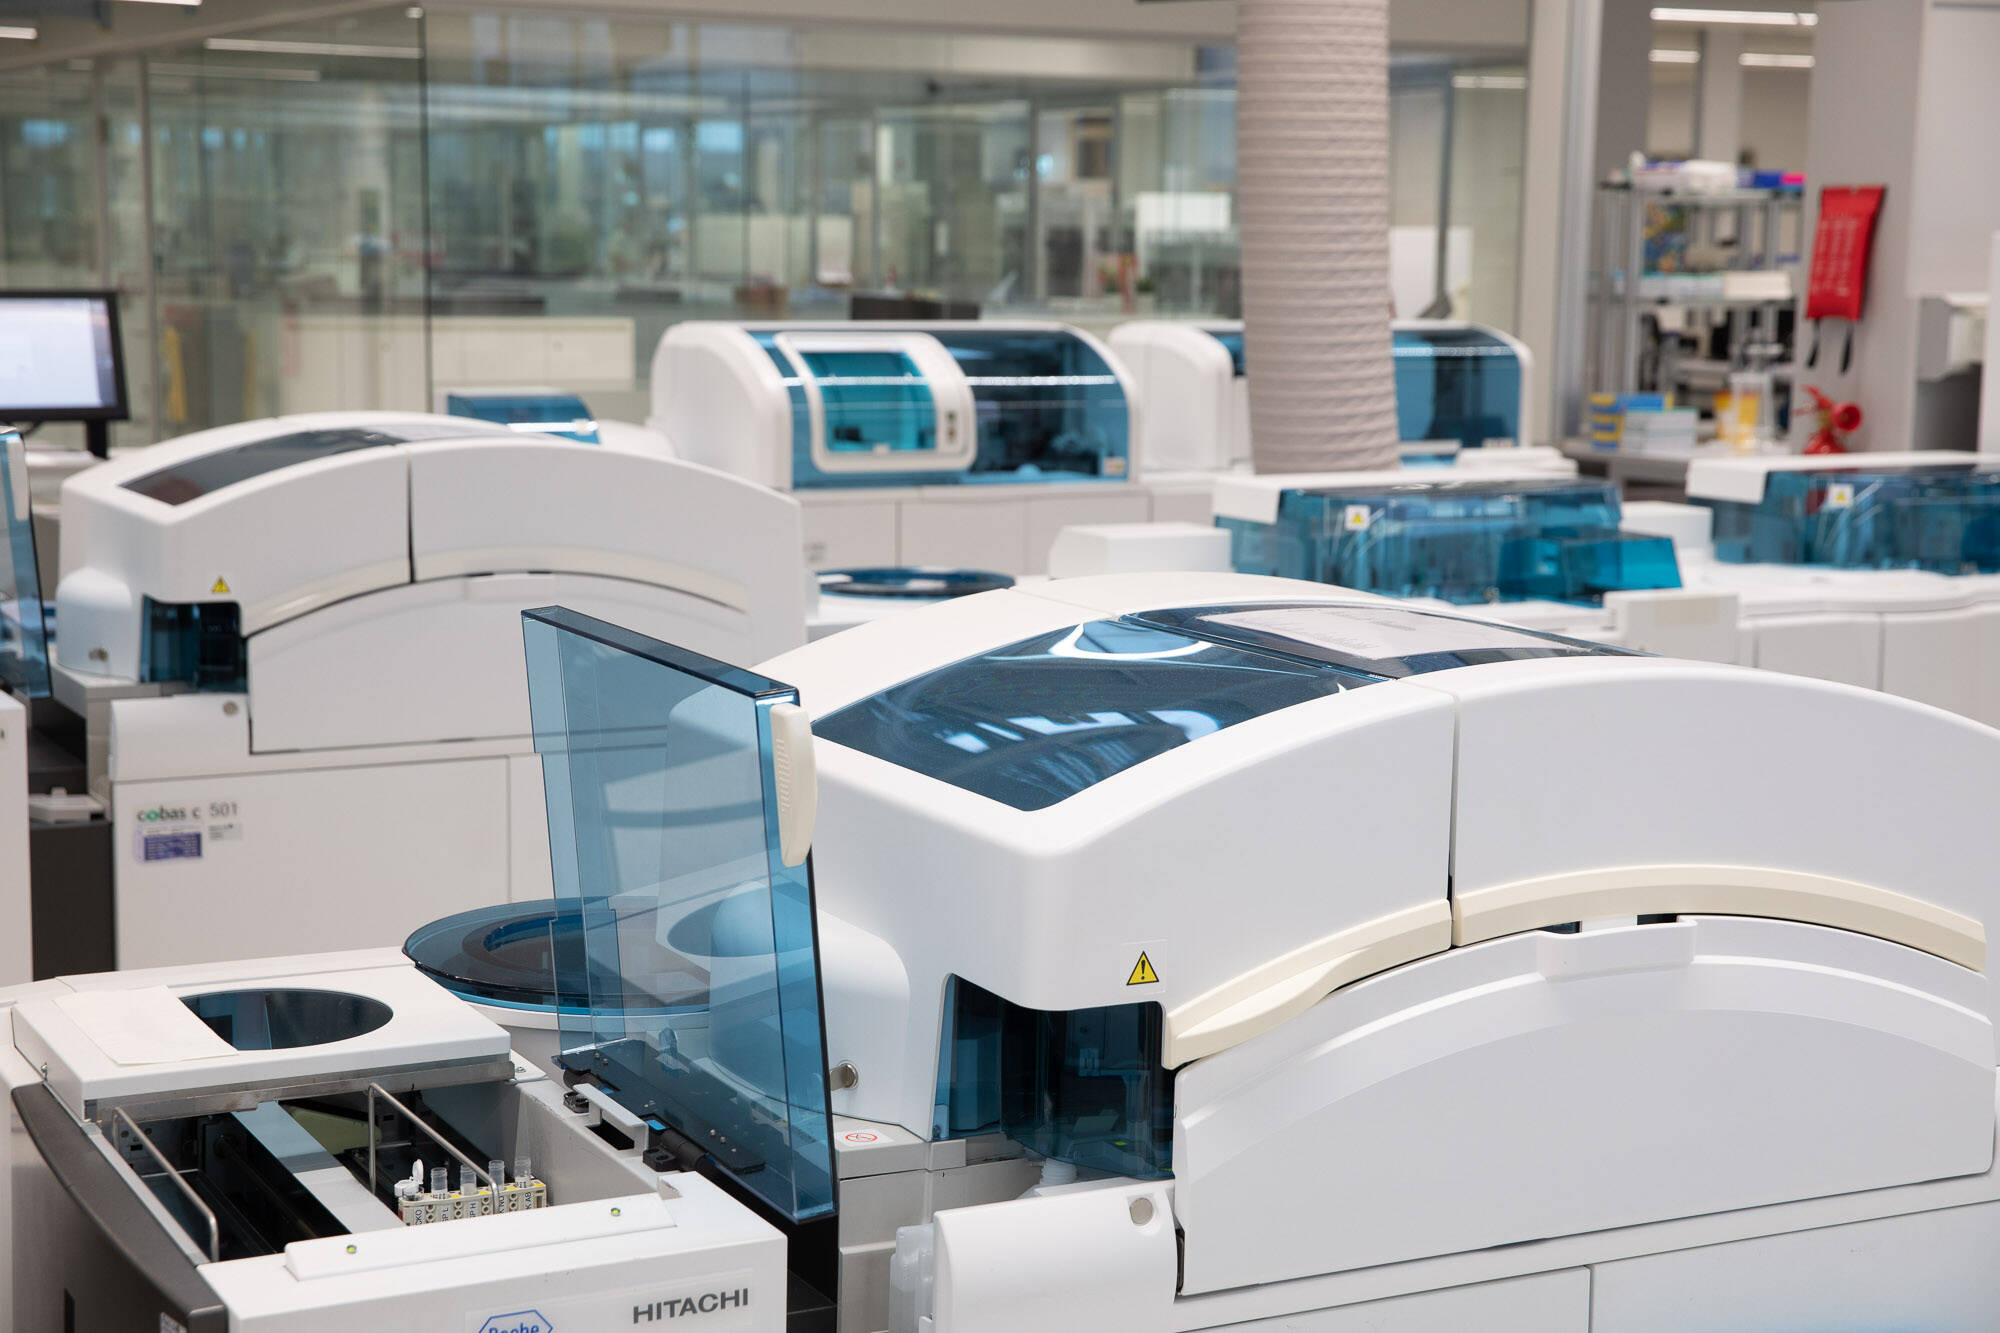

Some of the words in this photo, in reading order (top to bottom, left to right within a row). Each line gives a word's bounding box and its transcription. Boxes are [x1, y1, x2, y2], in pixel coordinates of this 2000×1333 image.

[137, 805, 186, 822] cobas
[192, 807, 201, 820] c
[209, 801, 237, 817] 501
[633, 1288, 749, 1324] HITACHI
